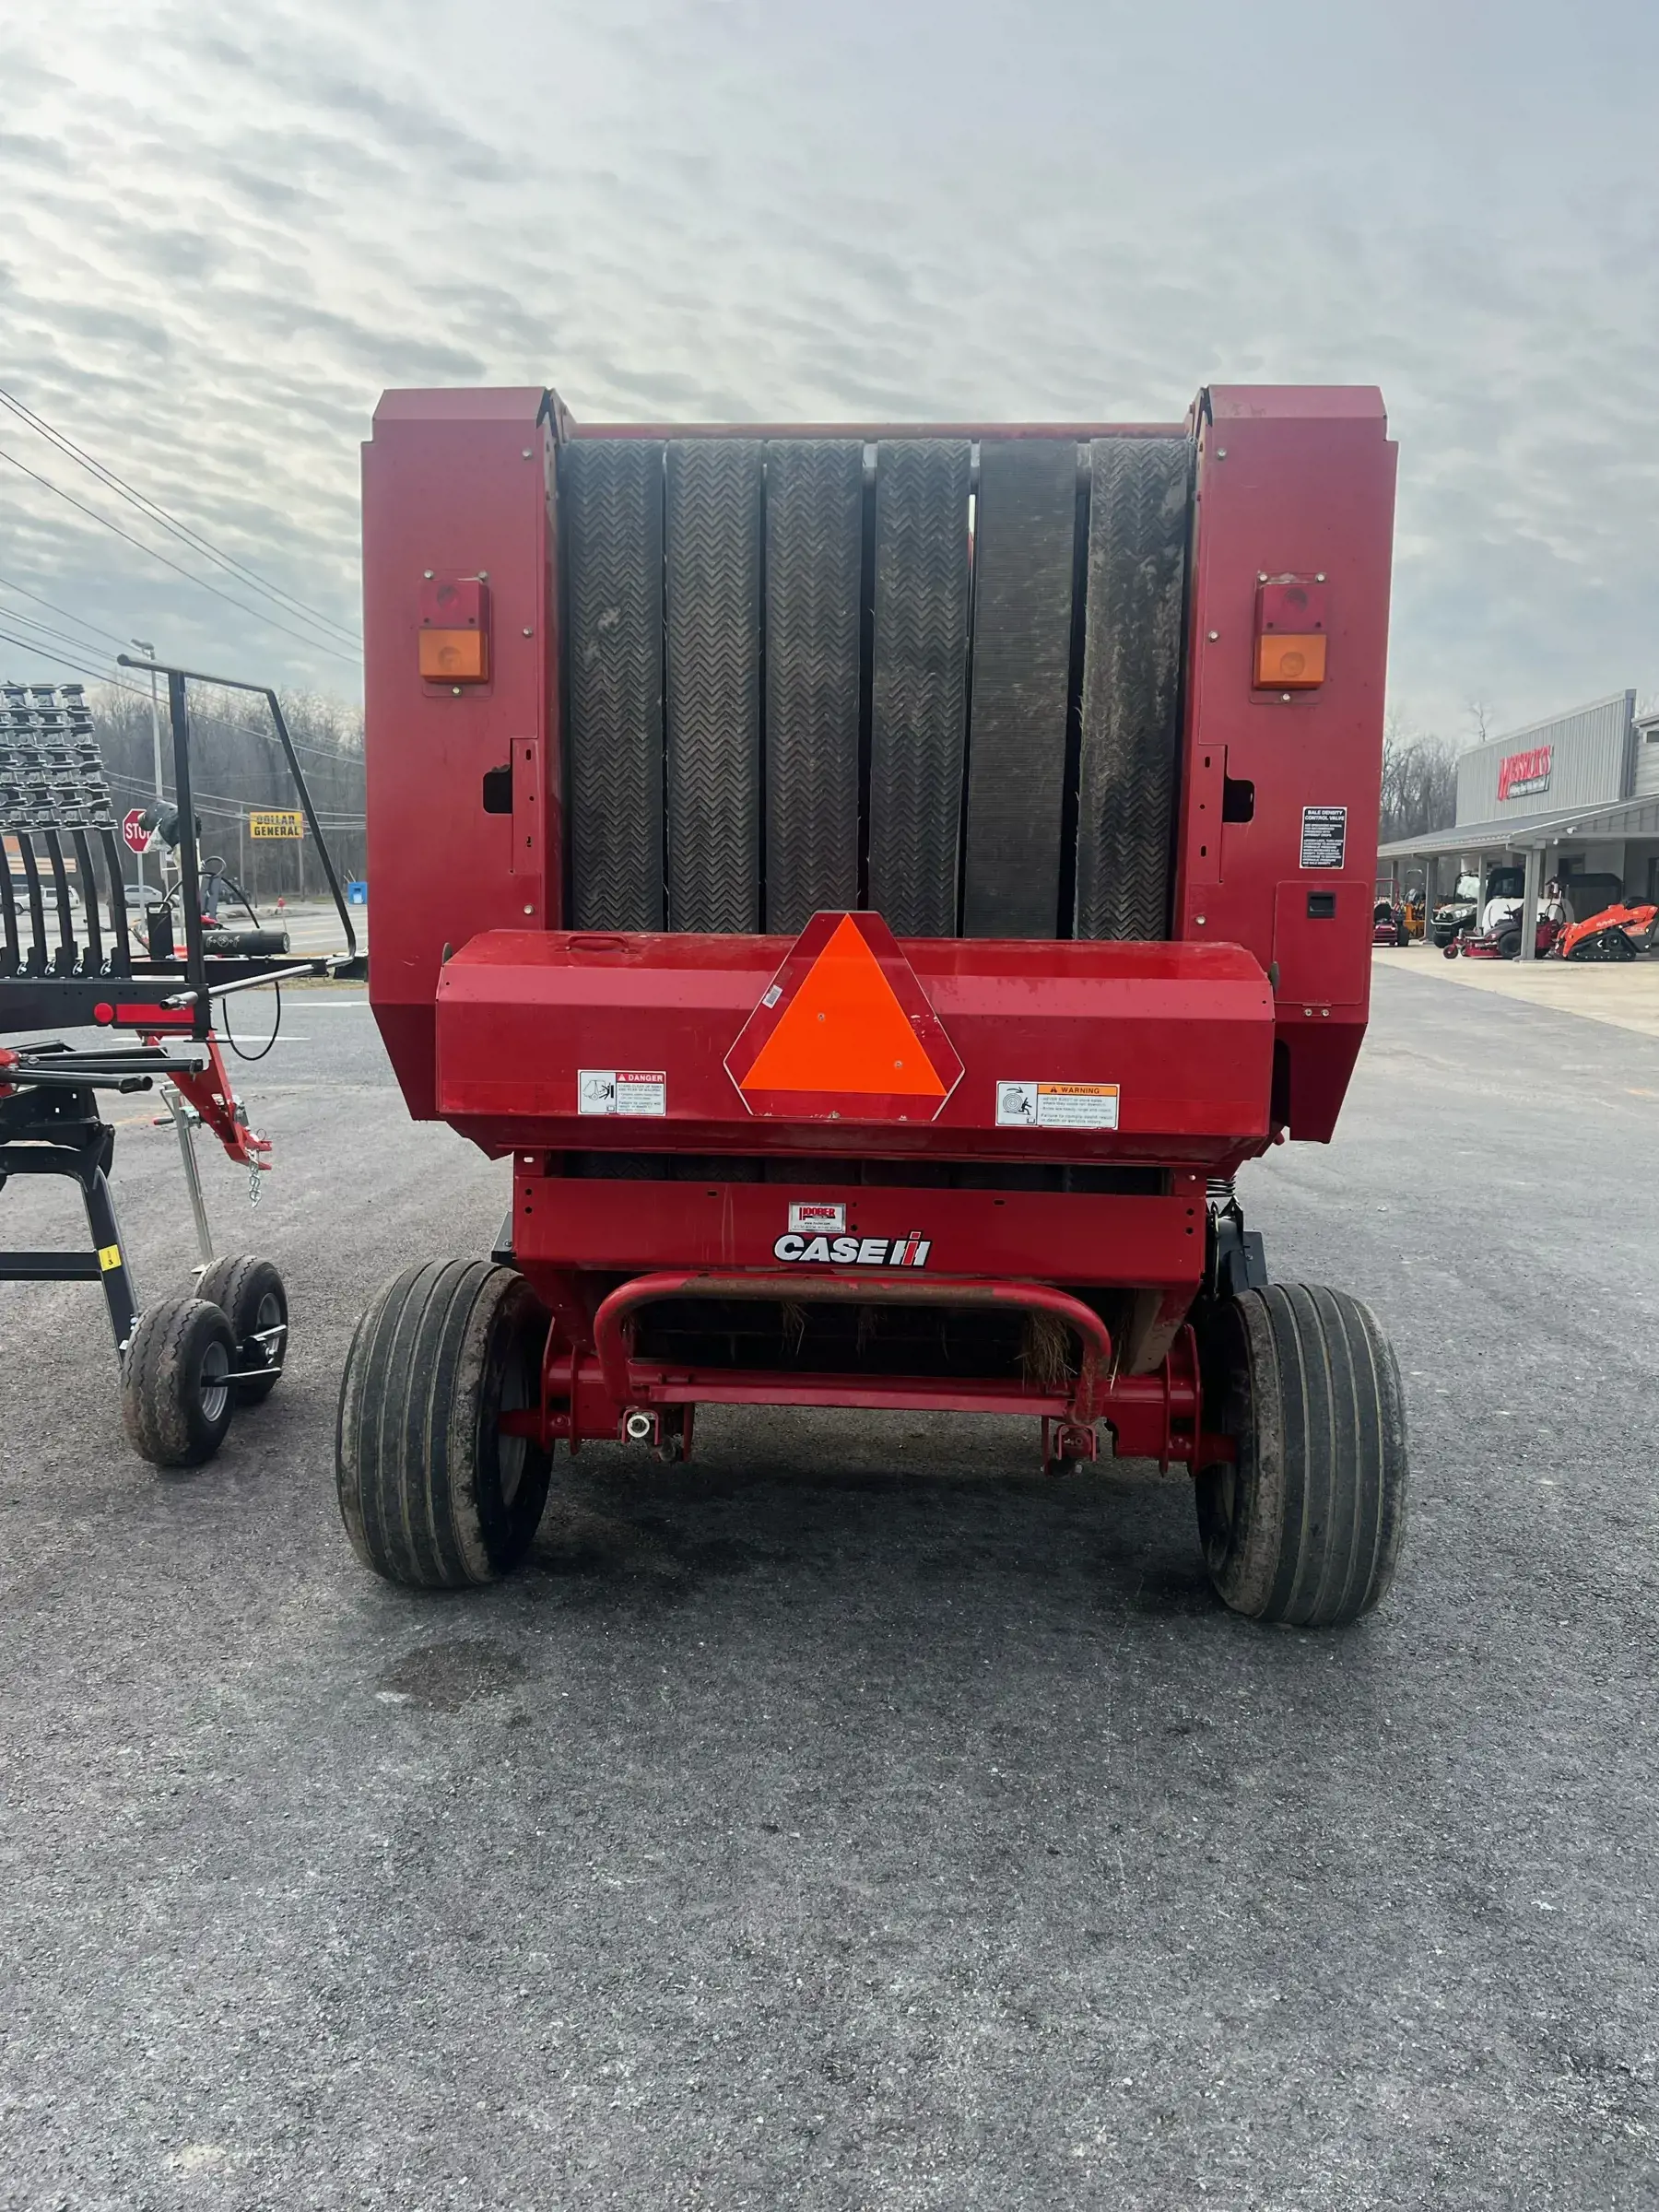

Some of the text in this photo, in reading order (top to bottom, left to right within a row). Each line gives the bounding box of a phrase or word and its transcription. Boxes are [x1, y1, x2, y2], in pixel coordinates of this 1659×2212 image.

[256, 815, 295, 825] DOLLAR
[254, 826, 300, 836] GENERAL
[628, 1074, 663, 1082] DANGER
[798, 1206, 836, 1220] HOOBER
[774, 1234, 889, 1265] CASE
